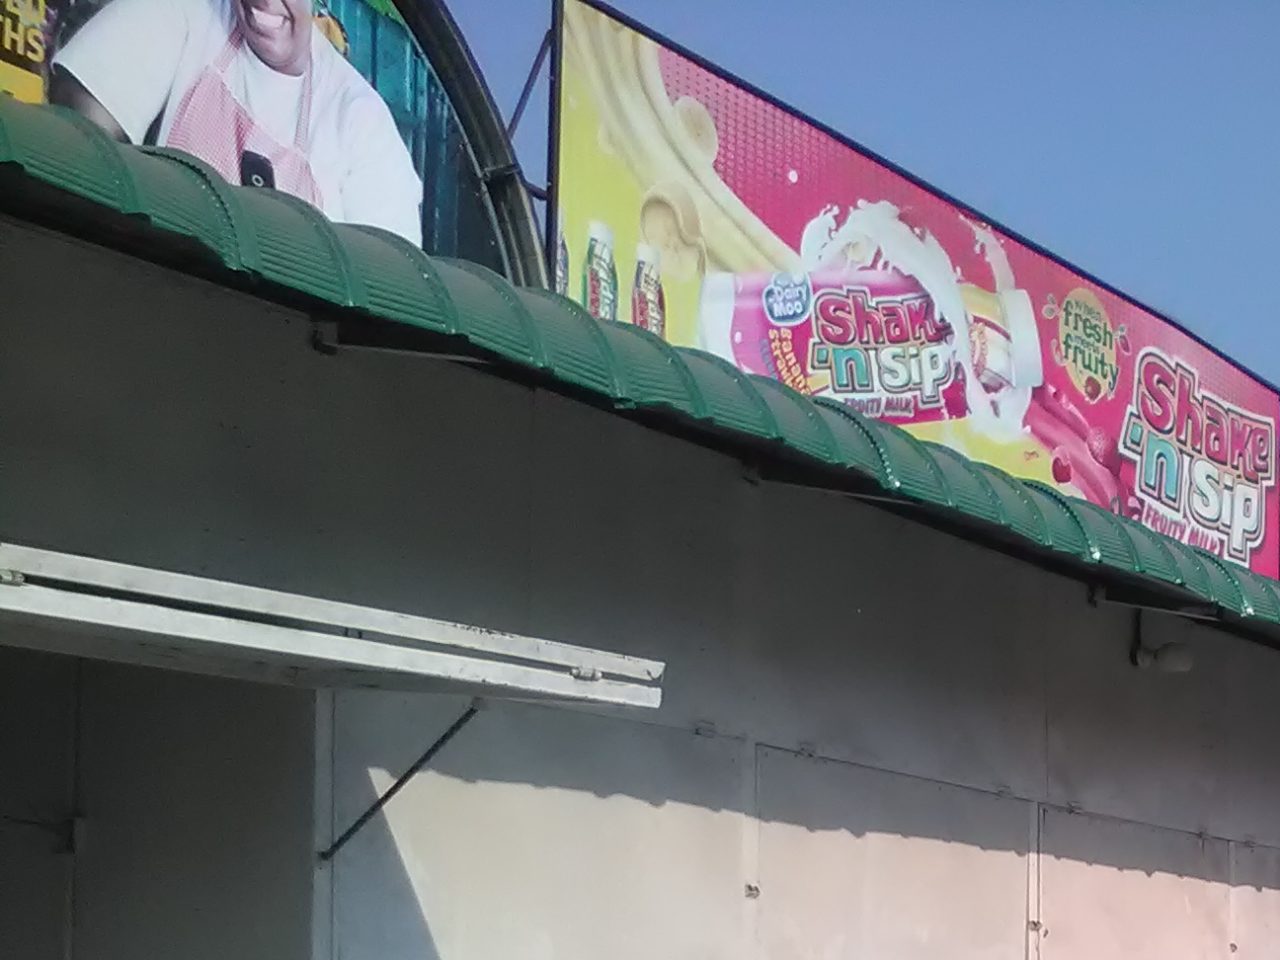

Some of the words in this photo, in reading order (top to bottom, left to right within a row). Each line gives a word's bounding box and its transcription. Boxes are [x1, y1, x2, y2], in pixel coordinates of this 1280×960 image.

[773, 300, 804, 317] Moo
[1062, 299, 1114, 350] fresh
[1062, 332, 1120, 392] fruity
[1138, 358, 1272, 486] Shake
